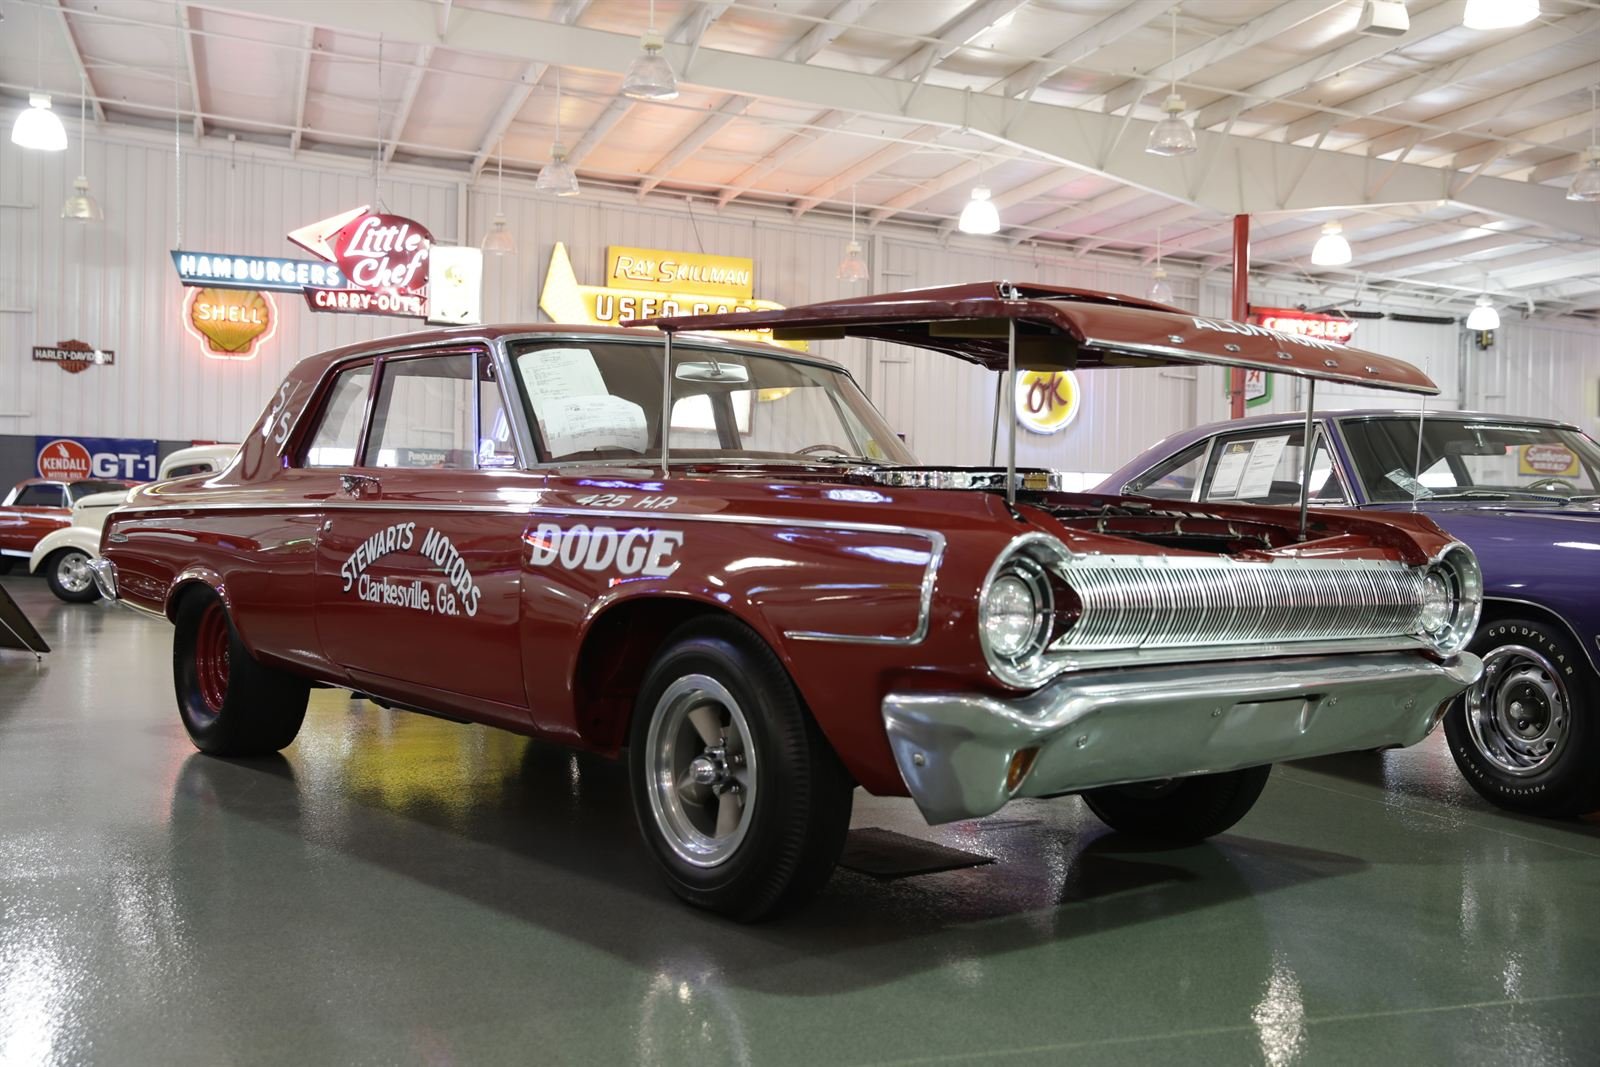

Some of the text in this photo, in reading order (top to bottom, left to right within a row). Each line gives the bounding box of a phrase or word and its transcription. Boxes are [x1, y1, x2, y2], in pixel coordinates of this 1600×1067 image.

[343, 216, 427, 287] Little Chef
[180, 255, 341, 286] HAMBURGERS
[613, 256, 750, 286] RAY SKILLMAN
[198, 303, 263, 325] SHELL
[315, 290, 423, 313] CARRY-OUTS
[35, 349, 113, 362] HARLEY-DAVIDON
[1027, 372, 1068, 414] OK
[43, 457, 88, 471] KENDALL
[92, 453, 157, 479] GT-1
[575, 493, 633, 507] 425
[530, 523, 684, 577] DODGE
[341, 521, 482, 617] STEWARTS MOTORS
[358, 574, 460, 616] Clarkesville, Ga.
[1488, 625, 1574, 675] GOODYEAR
